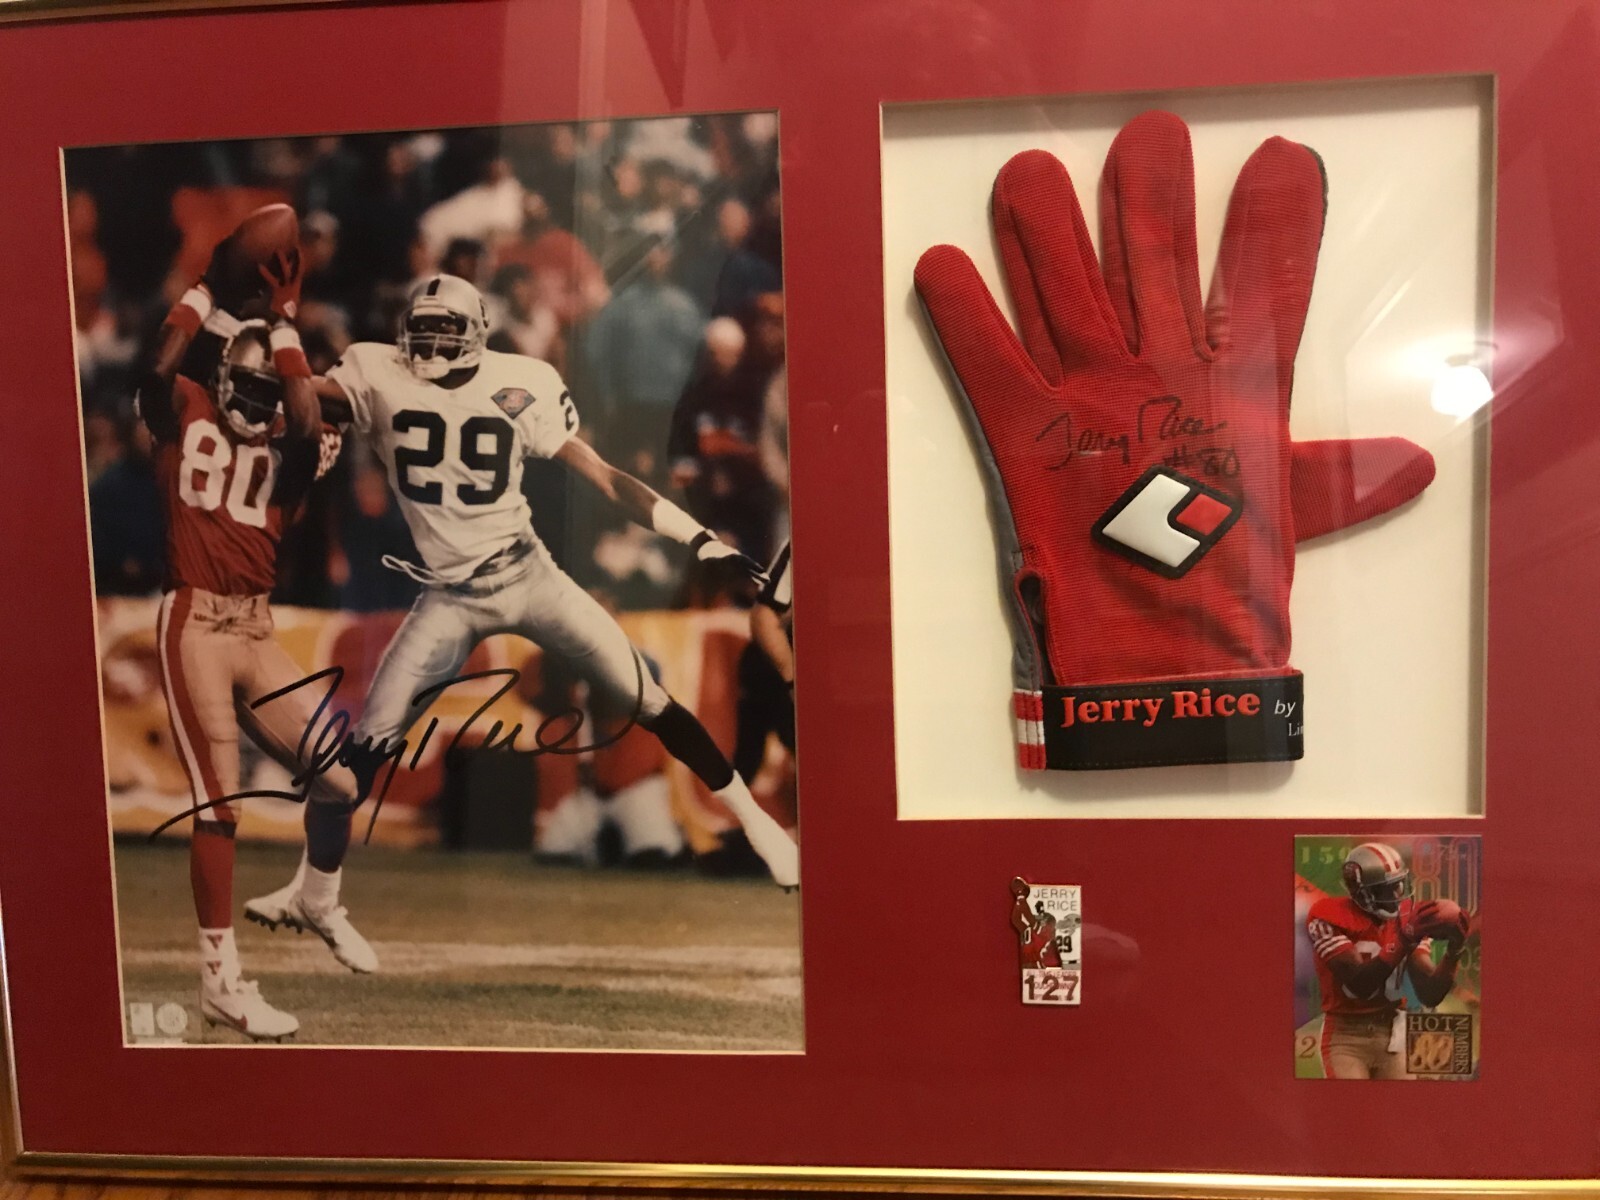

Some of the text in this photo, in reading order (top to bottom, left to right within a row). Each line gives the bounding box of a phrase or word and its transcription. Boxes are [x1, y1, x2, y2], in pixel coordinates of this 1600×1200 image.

[392, 409, 515, 506] 29
[178, 418, 280, 528] 80
[1060, 687, 1296, 728] Jerry Rice by
[1033, 888, 1077, 899] JERRY
[1047, 900, 1078, 911] RICE
[1055, 935, 1073, 953] 29
[1024, 974, 1079, 1001] 127
[1408, 1015, 1454, 1032] HOT
[1454, 1015, 1470, 1074] NUMBERS
